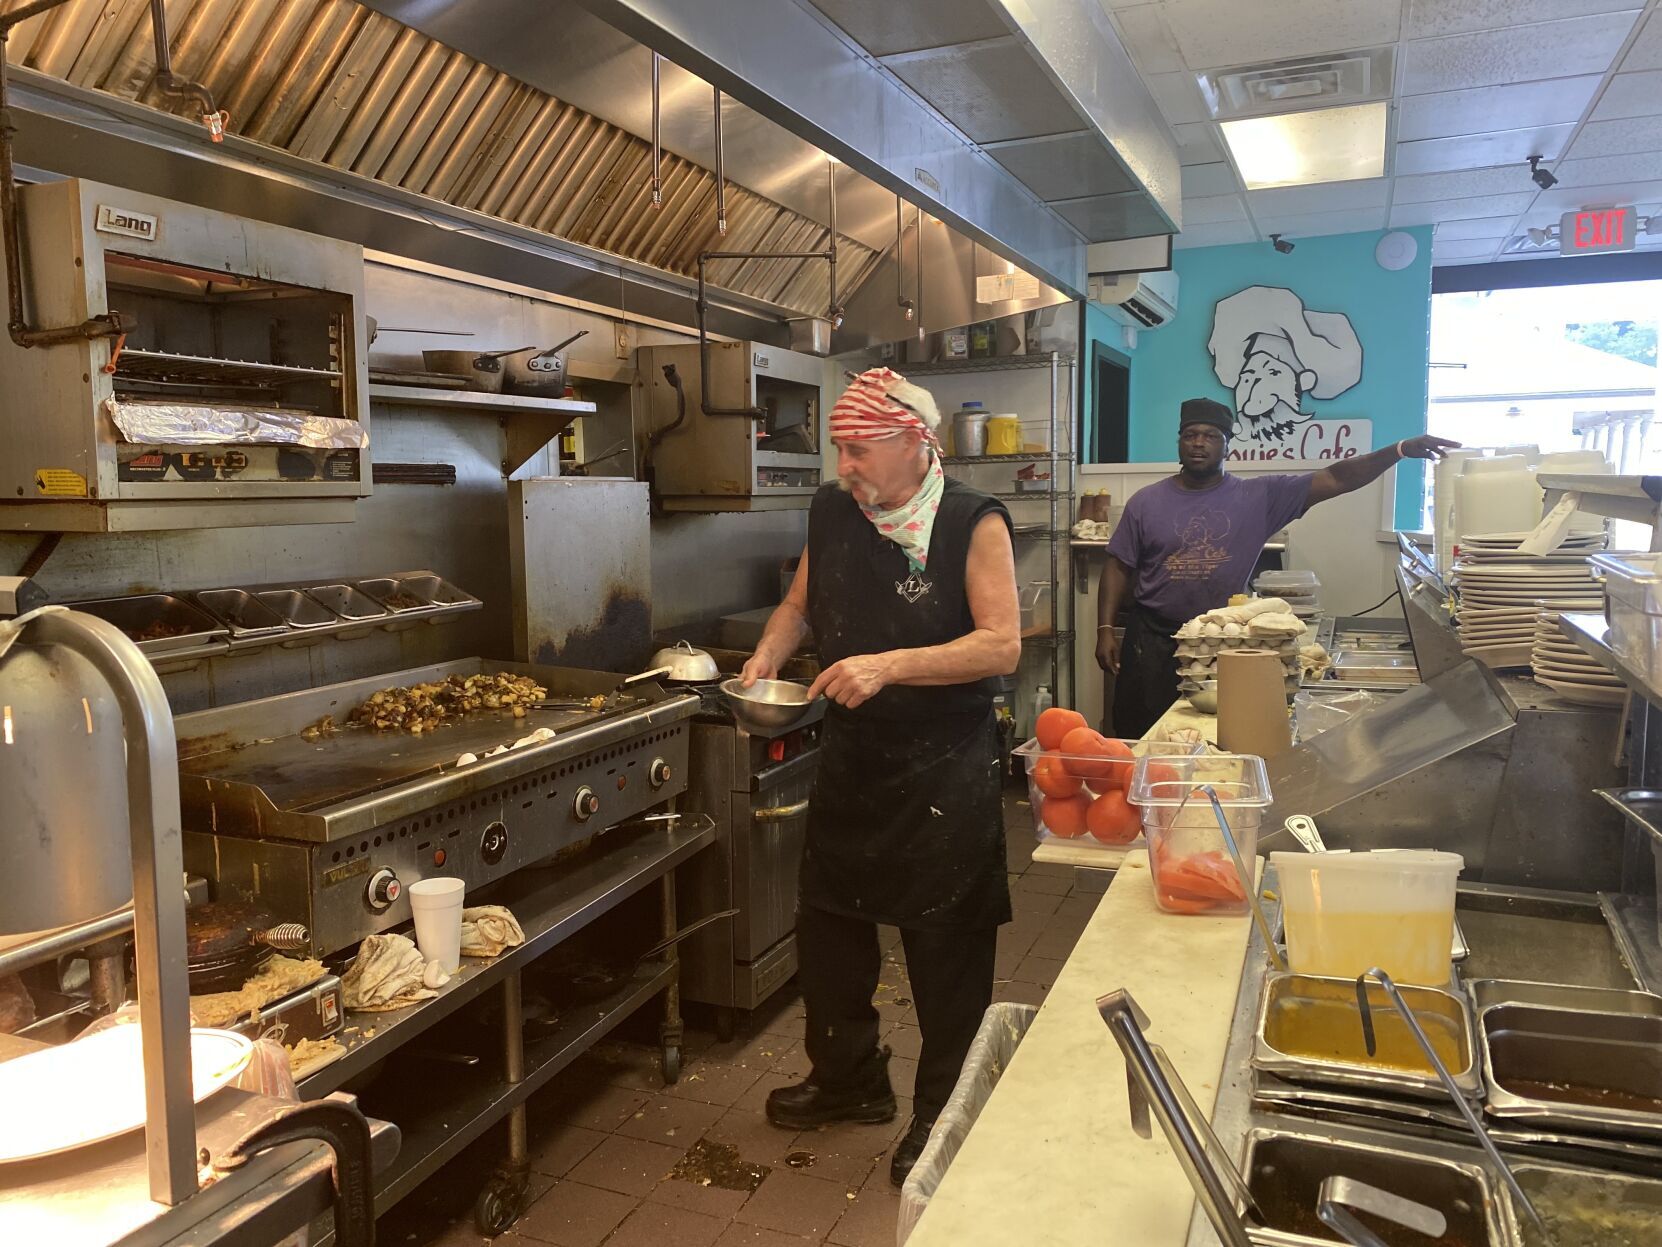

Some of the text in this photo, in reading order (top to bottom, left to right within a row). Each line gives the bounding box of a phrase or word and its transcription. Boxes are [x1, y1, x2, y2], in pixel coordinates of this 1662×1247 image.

[104, 208, 152, 236] Lang
[1574, 209, 1627, 248] EXIT
[1300, 423, 1357, 459] Cafe
